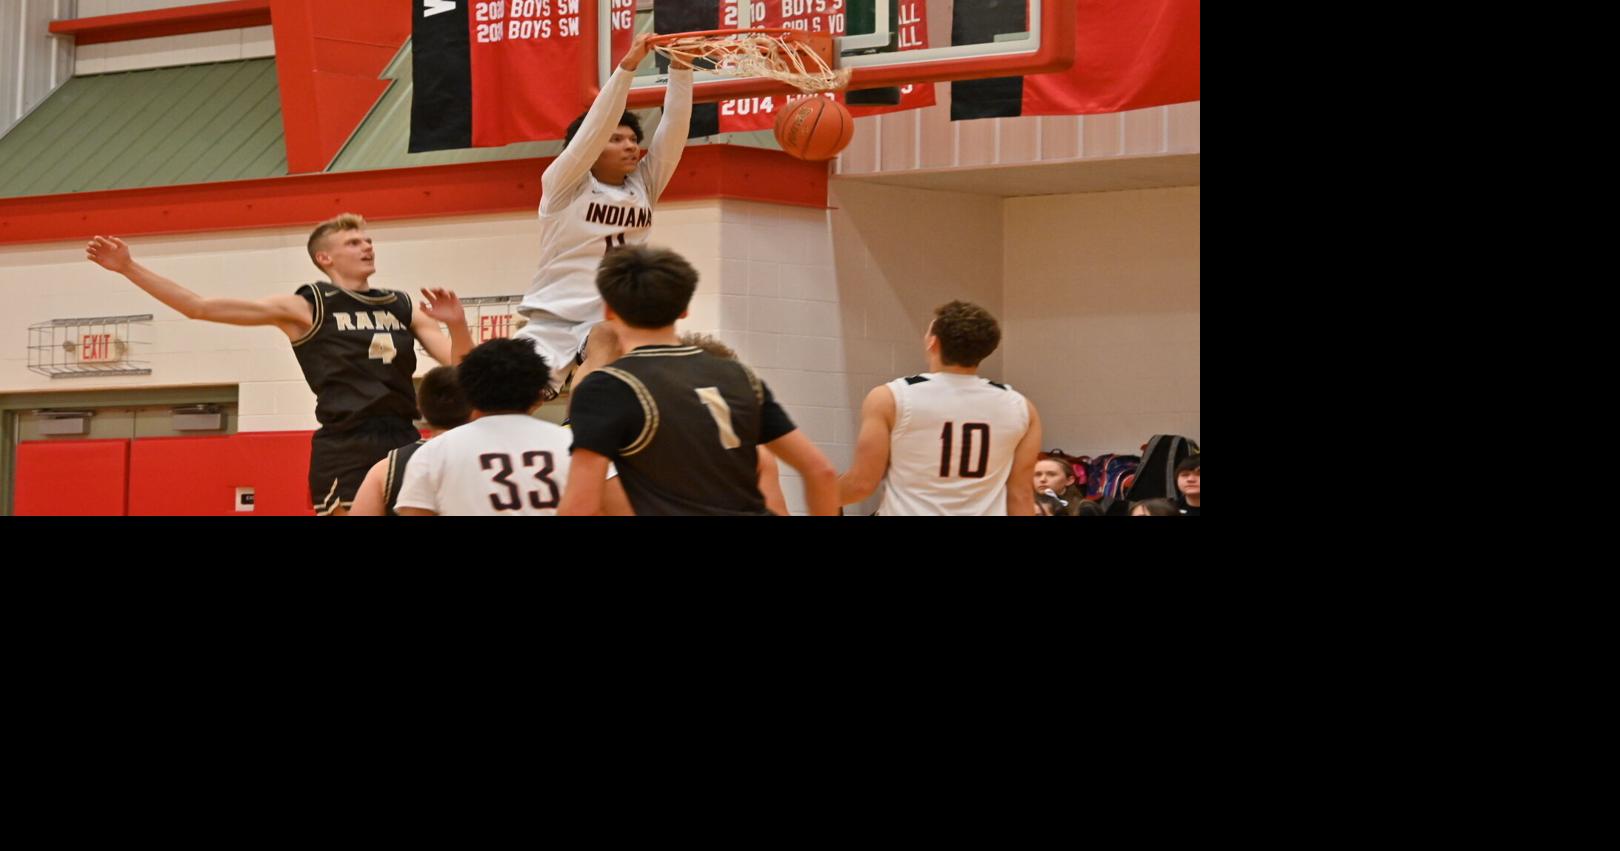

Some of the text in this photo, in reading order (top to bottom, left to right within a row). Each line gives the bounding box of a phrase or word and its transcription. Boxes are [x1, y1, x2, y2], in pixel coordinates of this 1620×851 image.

[511, 0, 551, 17] BOYS
[782, 0, 826, 17] BOYS
[508, 19, 552, 39] BOYS
[721, 96, 774, 116] 2014
[332, 310, 408, 331] RAM
[480, 314, 513, 343] EXIT
[82, 334, 111, 360] EXIT
[368, 332, 397, 365] 4
[693, 386, 742, 450] 1
[939, 420, 990, 479] 10
[479, 450, 561, 511] 33
